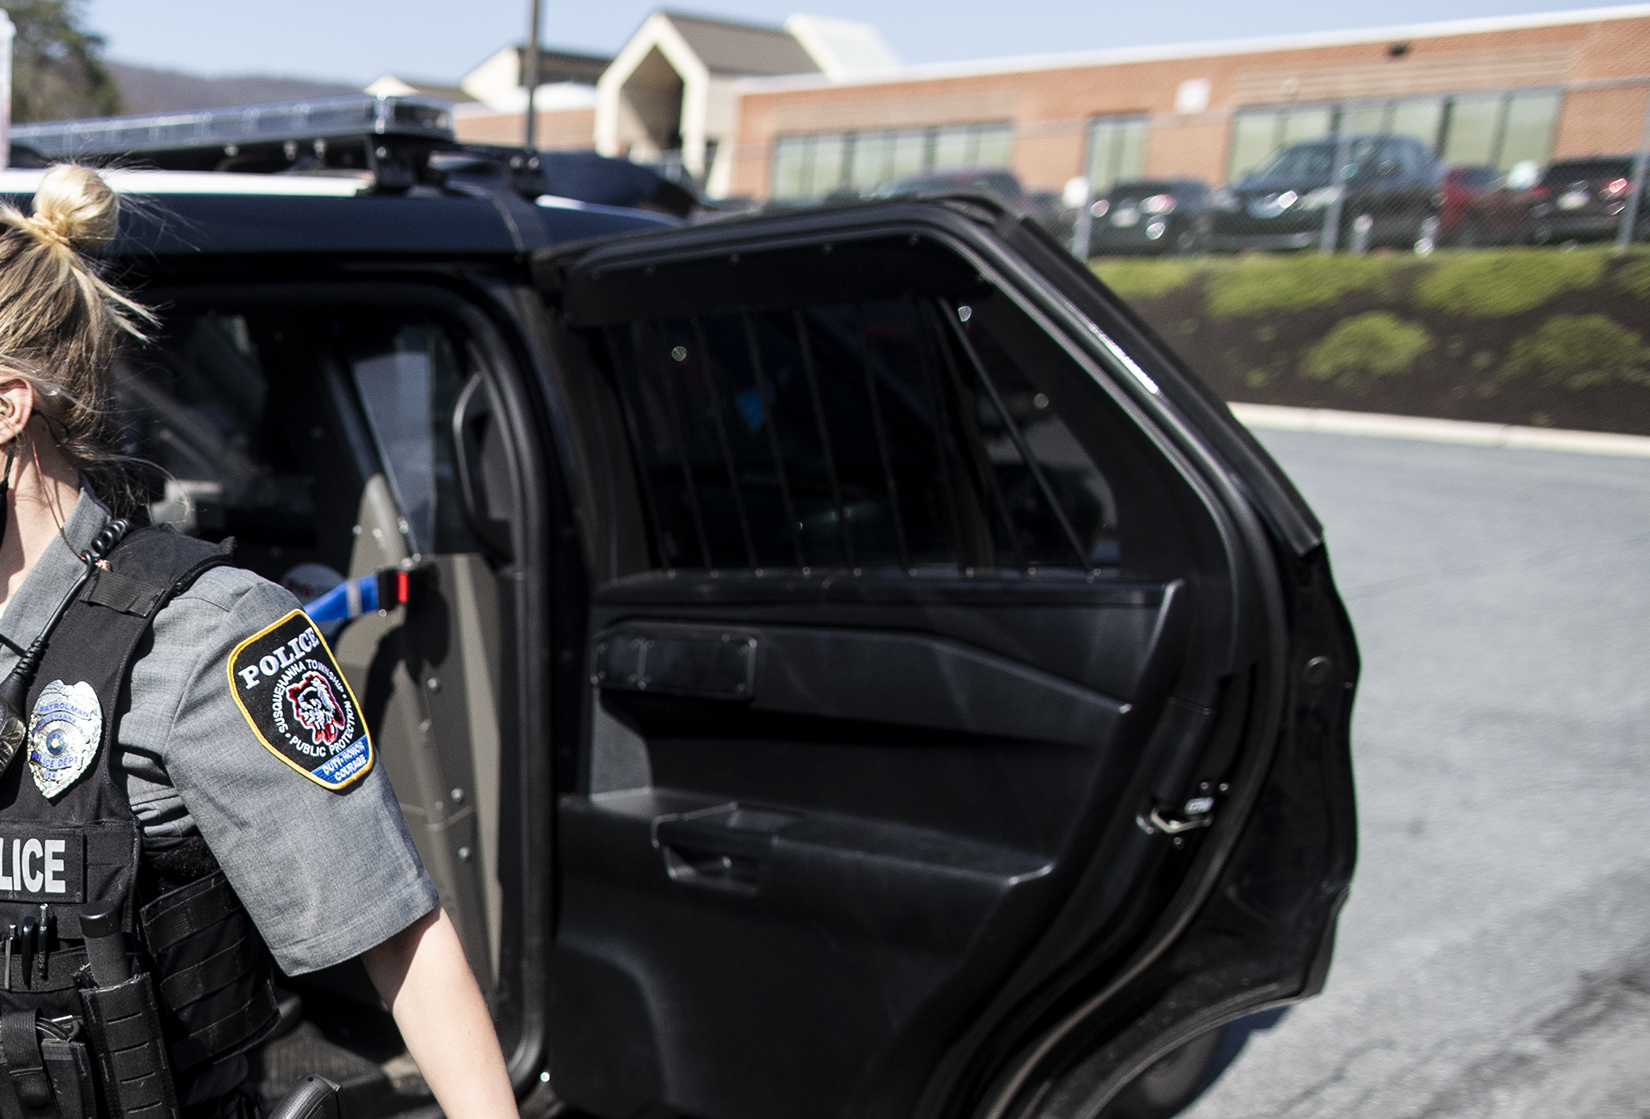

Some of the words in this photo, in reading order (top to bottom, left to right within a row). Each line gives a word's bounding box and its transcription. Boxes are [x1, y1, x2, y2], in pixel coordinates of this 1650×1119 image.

[238, 627, 320, 689] POLICE
[40, 703, 89, 718] PATROLMAN
[272, 661, 306, 734] SUSQUEHANNA
[305, 658, 344, 693] TOWNSHIP
[288, 735, 326, 757] PUBLIC
[329, 701, 355, 755] PROTECTION
